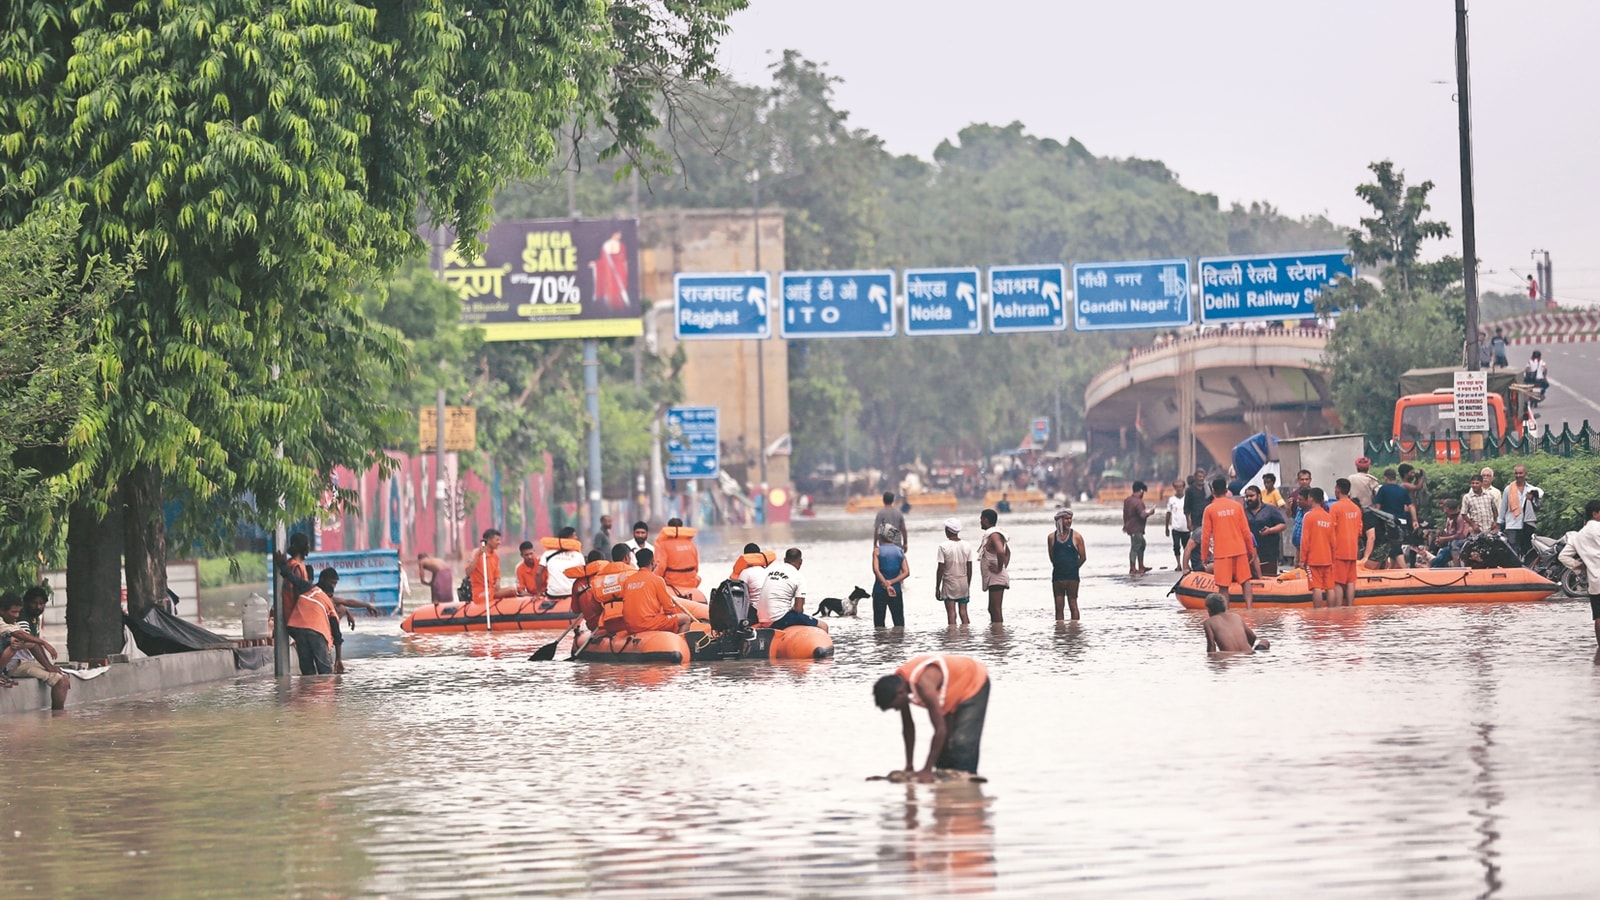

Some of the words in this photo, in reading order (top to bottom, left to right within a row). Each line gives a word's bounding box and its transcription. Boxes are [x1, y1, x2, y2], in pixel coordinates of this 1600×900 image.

[526, 231, 572, 249] MEGA
[522, 247, 578, 273] SALE
[1114, 273, 1142, 287] नगर
[1203, 264, 1243, 288] दिल्ली
[1247, 262, 1278, 284] रेलवे
[1286, 260, 1327, 282] स्टेशन
[528, 275, 580, 304] 70%
[681, 285, 745, 303] राजघाट
[785, 279, 812, 302] आई
[818, 278, 834, 301] टी
[839, 279, 858, 301] ओ
[908, 277, 947, 299] नोएडा
[992, 278, 1040, 296] आश्रम
[1080, 299, 1127, 314] Gandhi
[1130, 298, 1169, 314] Nagar
[1205, 292, 1240, 311] Delhi
[1247, 288, 1300, 310] Railway
[681, 308, 739, 329] Rajghat
[911, 304, 952, 321] Noida
[993, 302, 1050, 319] Ashram
[333, 559, 366, 569] POWER
[768, 571, 789, 580] NDRF
